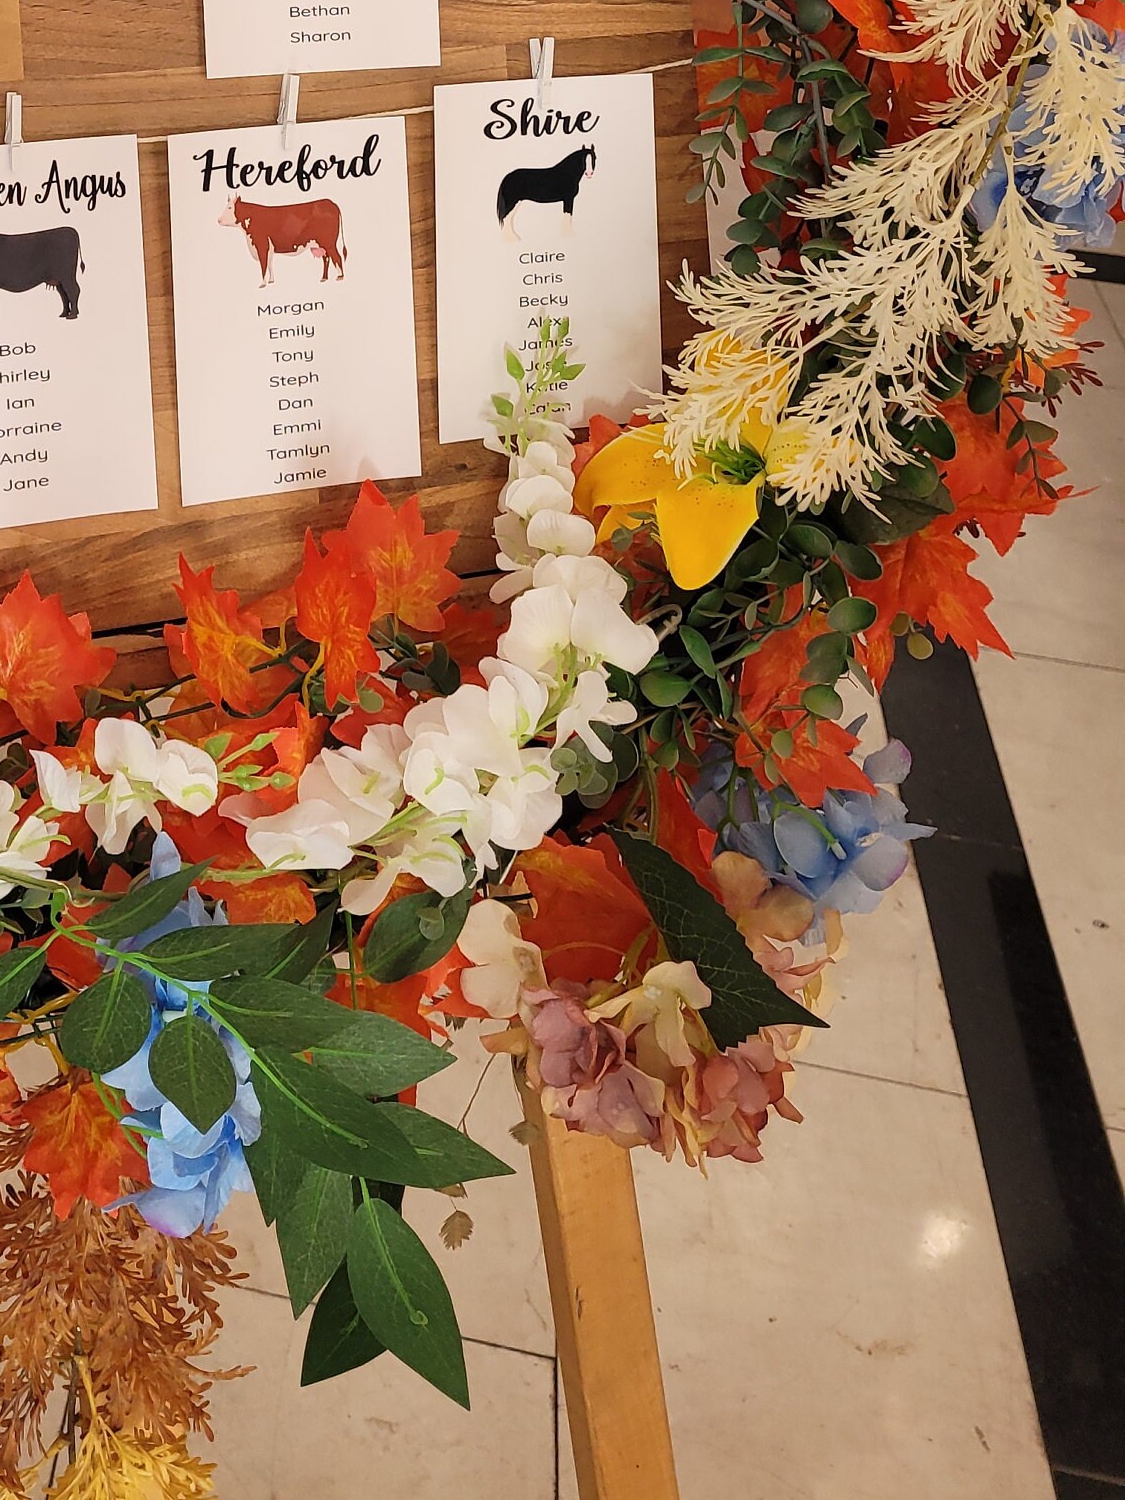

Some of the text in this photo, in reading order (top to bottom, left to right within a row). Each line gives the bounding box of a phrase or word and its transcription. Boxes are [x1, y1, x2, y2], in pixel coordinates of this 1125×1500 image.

[289, 4, 350, 18] Bethan
[290, 31, 351, 44] Sharon
[483, 97, 601, 141] Shire
[192, 133, 381, 192] Hereford
[34, 159, 127, 215] Angus
[519, 251, 565, 265] Claire
[522, 272, 563, 286] Chris
[519, 293, 568, 308] Becky
[257, 301, 325, 317] Morgan
[269, 324, 315, 340] Emily
[272, 350, 314, 363] Tony
[269, 371, 319, 388] Steph
[526, 381, 568, 393] Ktie
[6, 397, 36, 410] Ian
[278, 398, 313, 411] Dan
[273, 419, 321, 436] Emmi
[0, 448, 48, 466] Andy
[266, 444, 330, 461] Tamlyn
[273, 467, 327, 484] Jamie
[3, 477, 49, 492] Jane
